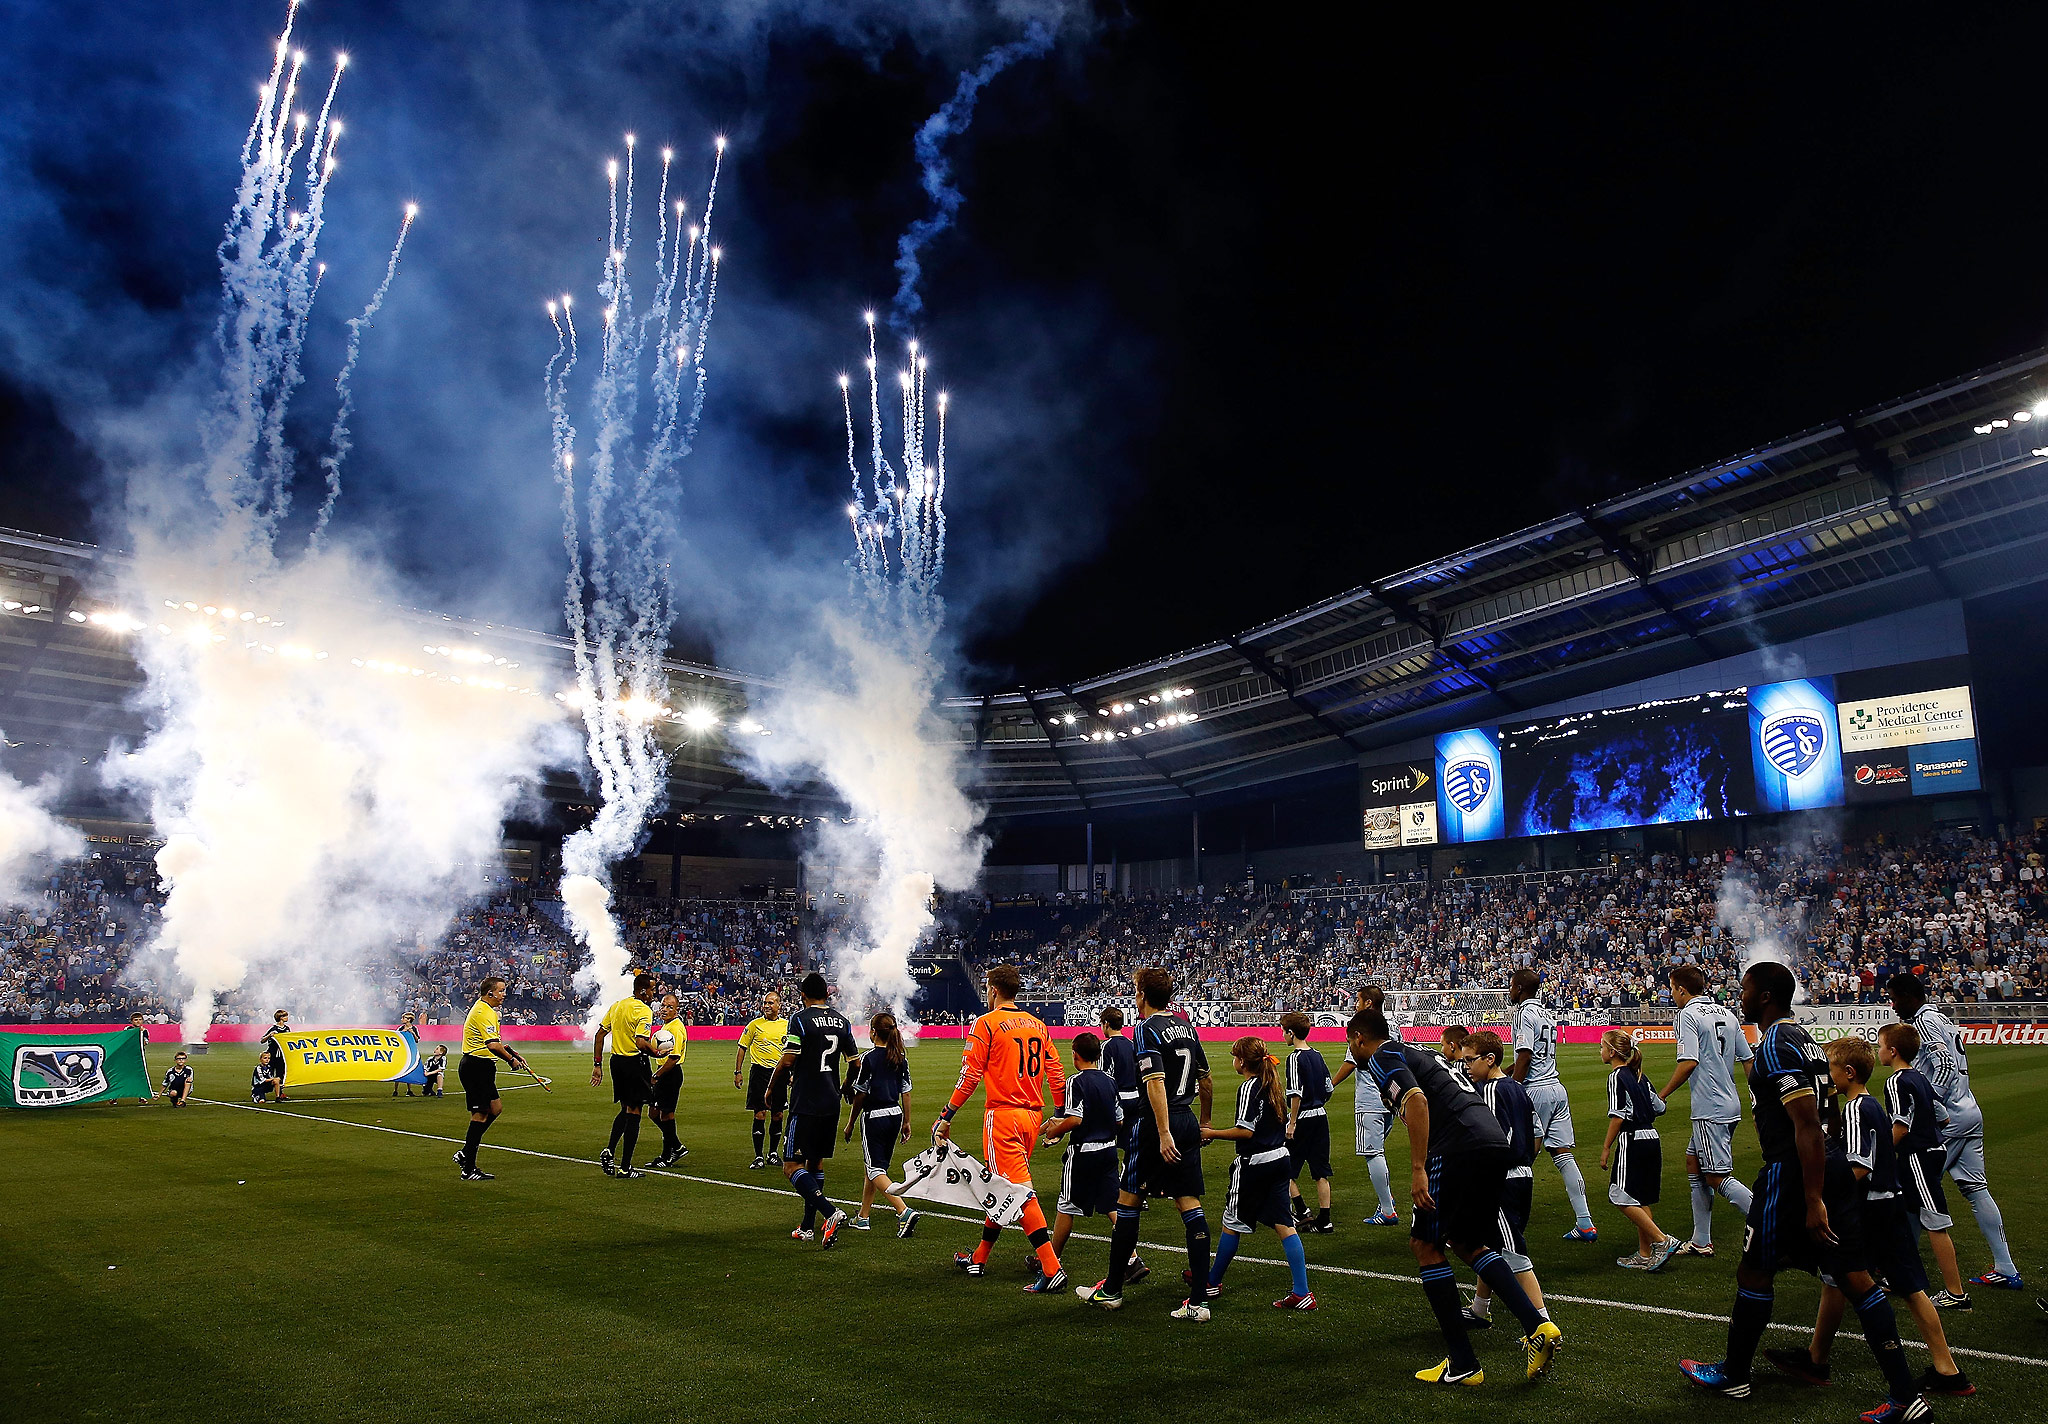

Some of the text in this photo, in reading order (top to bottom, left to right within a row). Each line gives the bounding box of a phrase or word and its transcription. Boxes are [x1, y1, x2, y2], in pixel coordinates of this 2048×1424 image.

[1877, 701, 1939, 716] Providence
[1766, 716, 1820, 733] SPORTING
[1878, 709, 1964, 727] Medical Center
[1851, 733, 1874, 741] Well
[1915, 759, 1968, 772] Panasonic
[1371, 775, 1411, 796] Sprint
[1364, 830, 1399, 842] Budweiser
[908, 966, 932, 976] Sprint
[1068, 1004, 1088, 1013] SOUTH
[1829, 1009, 1890, 1021] AD ASTRA
[811, 1016, 844, 1029] VALDES
[1090, 1007, 1139, 1027] STH
[287, 1035, 400, 1051] MY GAME IS
[1644, 1030, 1676, 1040] SERIE
[1714, 1021, 1728, 1056] 5
[1855, 1027, 1878, 1043] 36
[303, 1049, 394, 1065] FAIR PLAY
[820, 1034, 839, 1072] 2
[1013, 1036, 1042, 1079] 18
[1175, 1047, 1192, 1096] 7
[48, 1096, 75, 1104] LEAGUE
[76, 1085, 103, 1098] SOCCER
